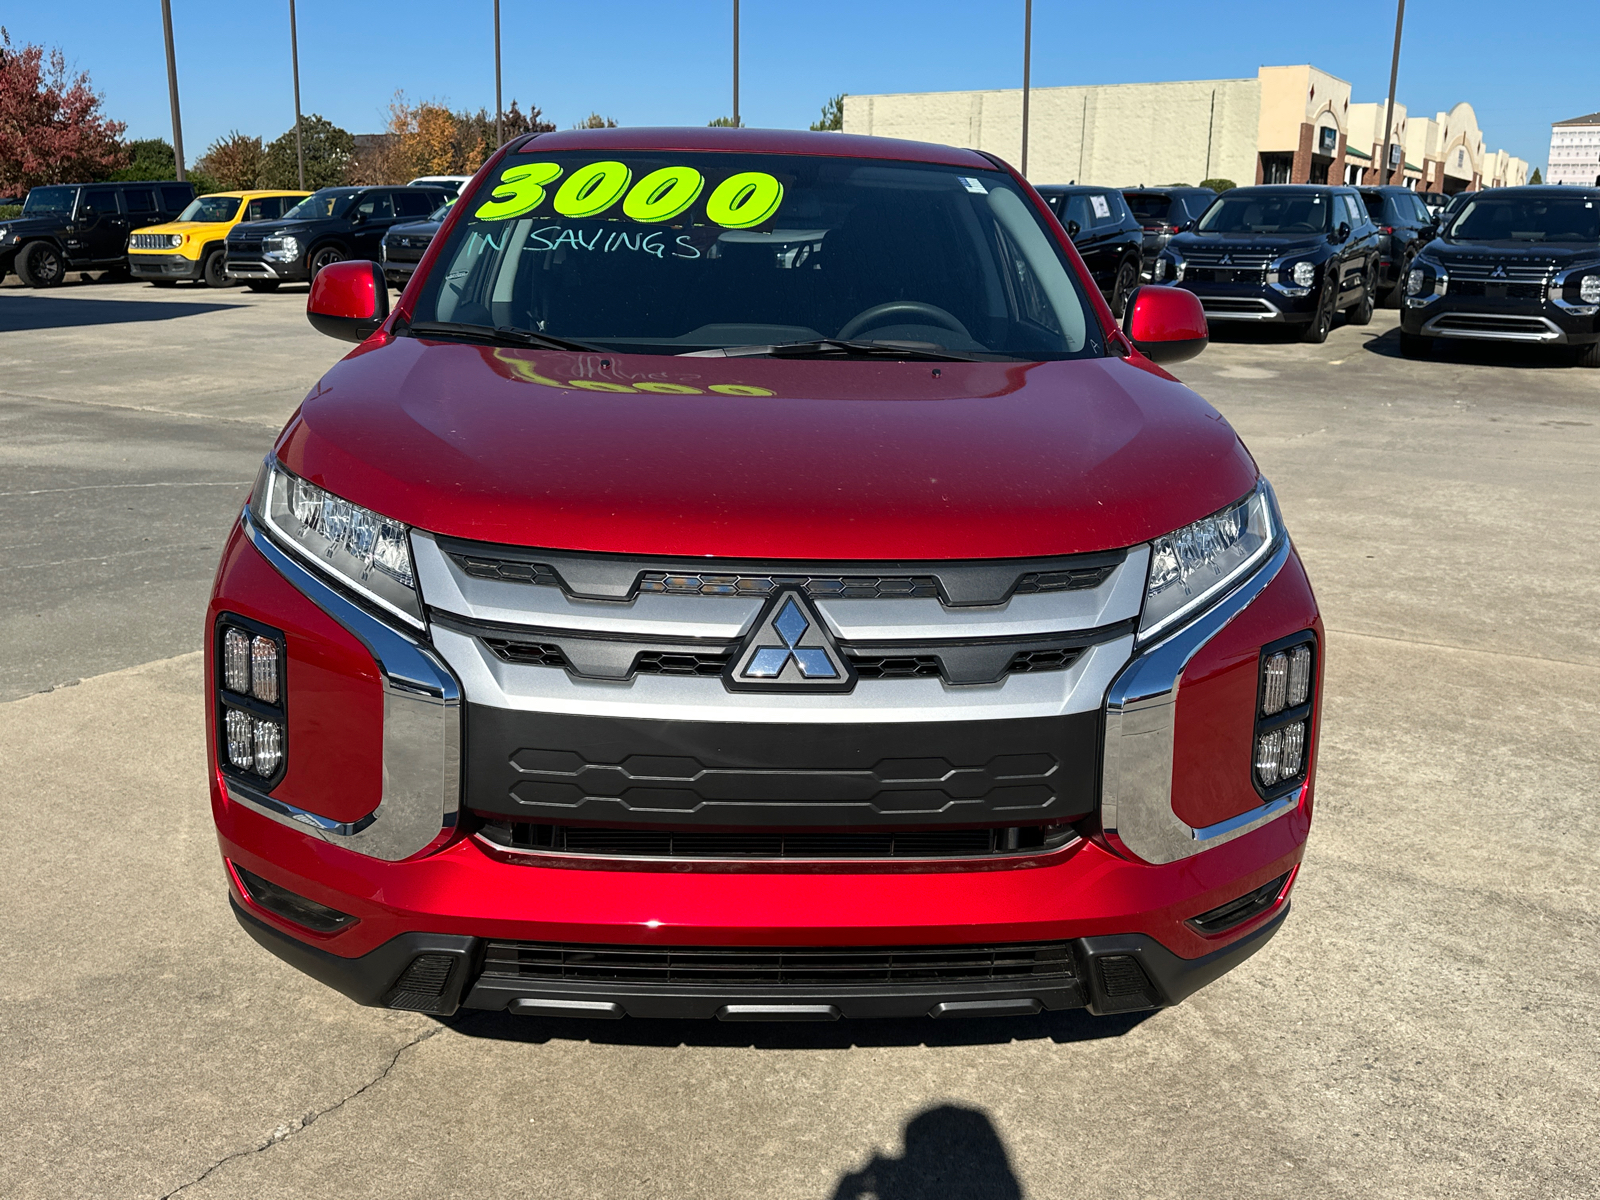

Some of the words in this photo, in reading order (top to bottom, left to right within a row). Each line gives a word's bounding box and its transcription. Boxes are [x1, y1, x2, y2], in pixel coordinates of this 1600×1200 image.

[475, 160, 784, 228] 3000
[466, 228, 508, 257] IN
[522, 226, 701, 258] SAVINGS
